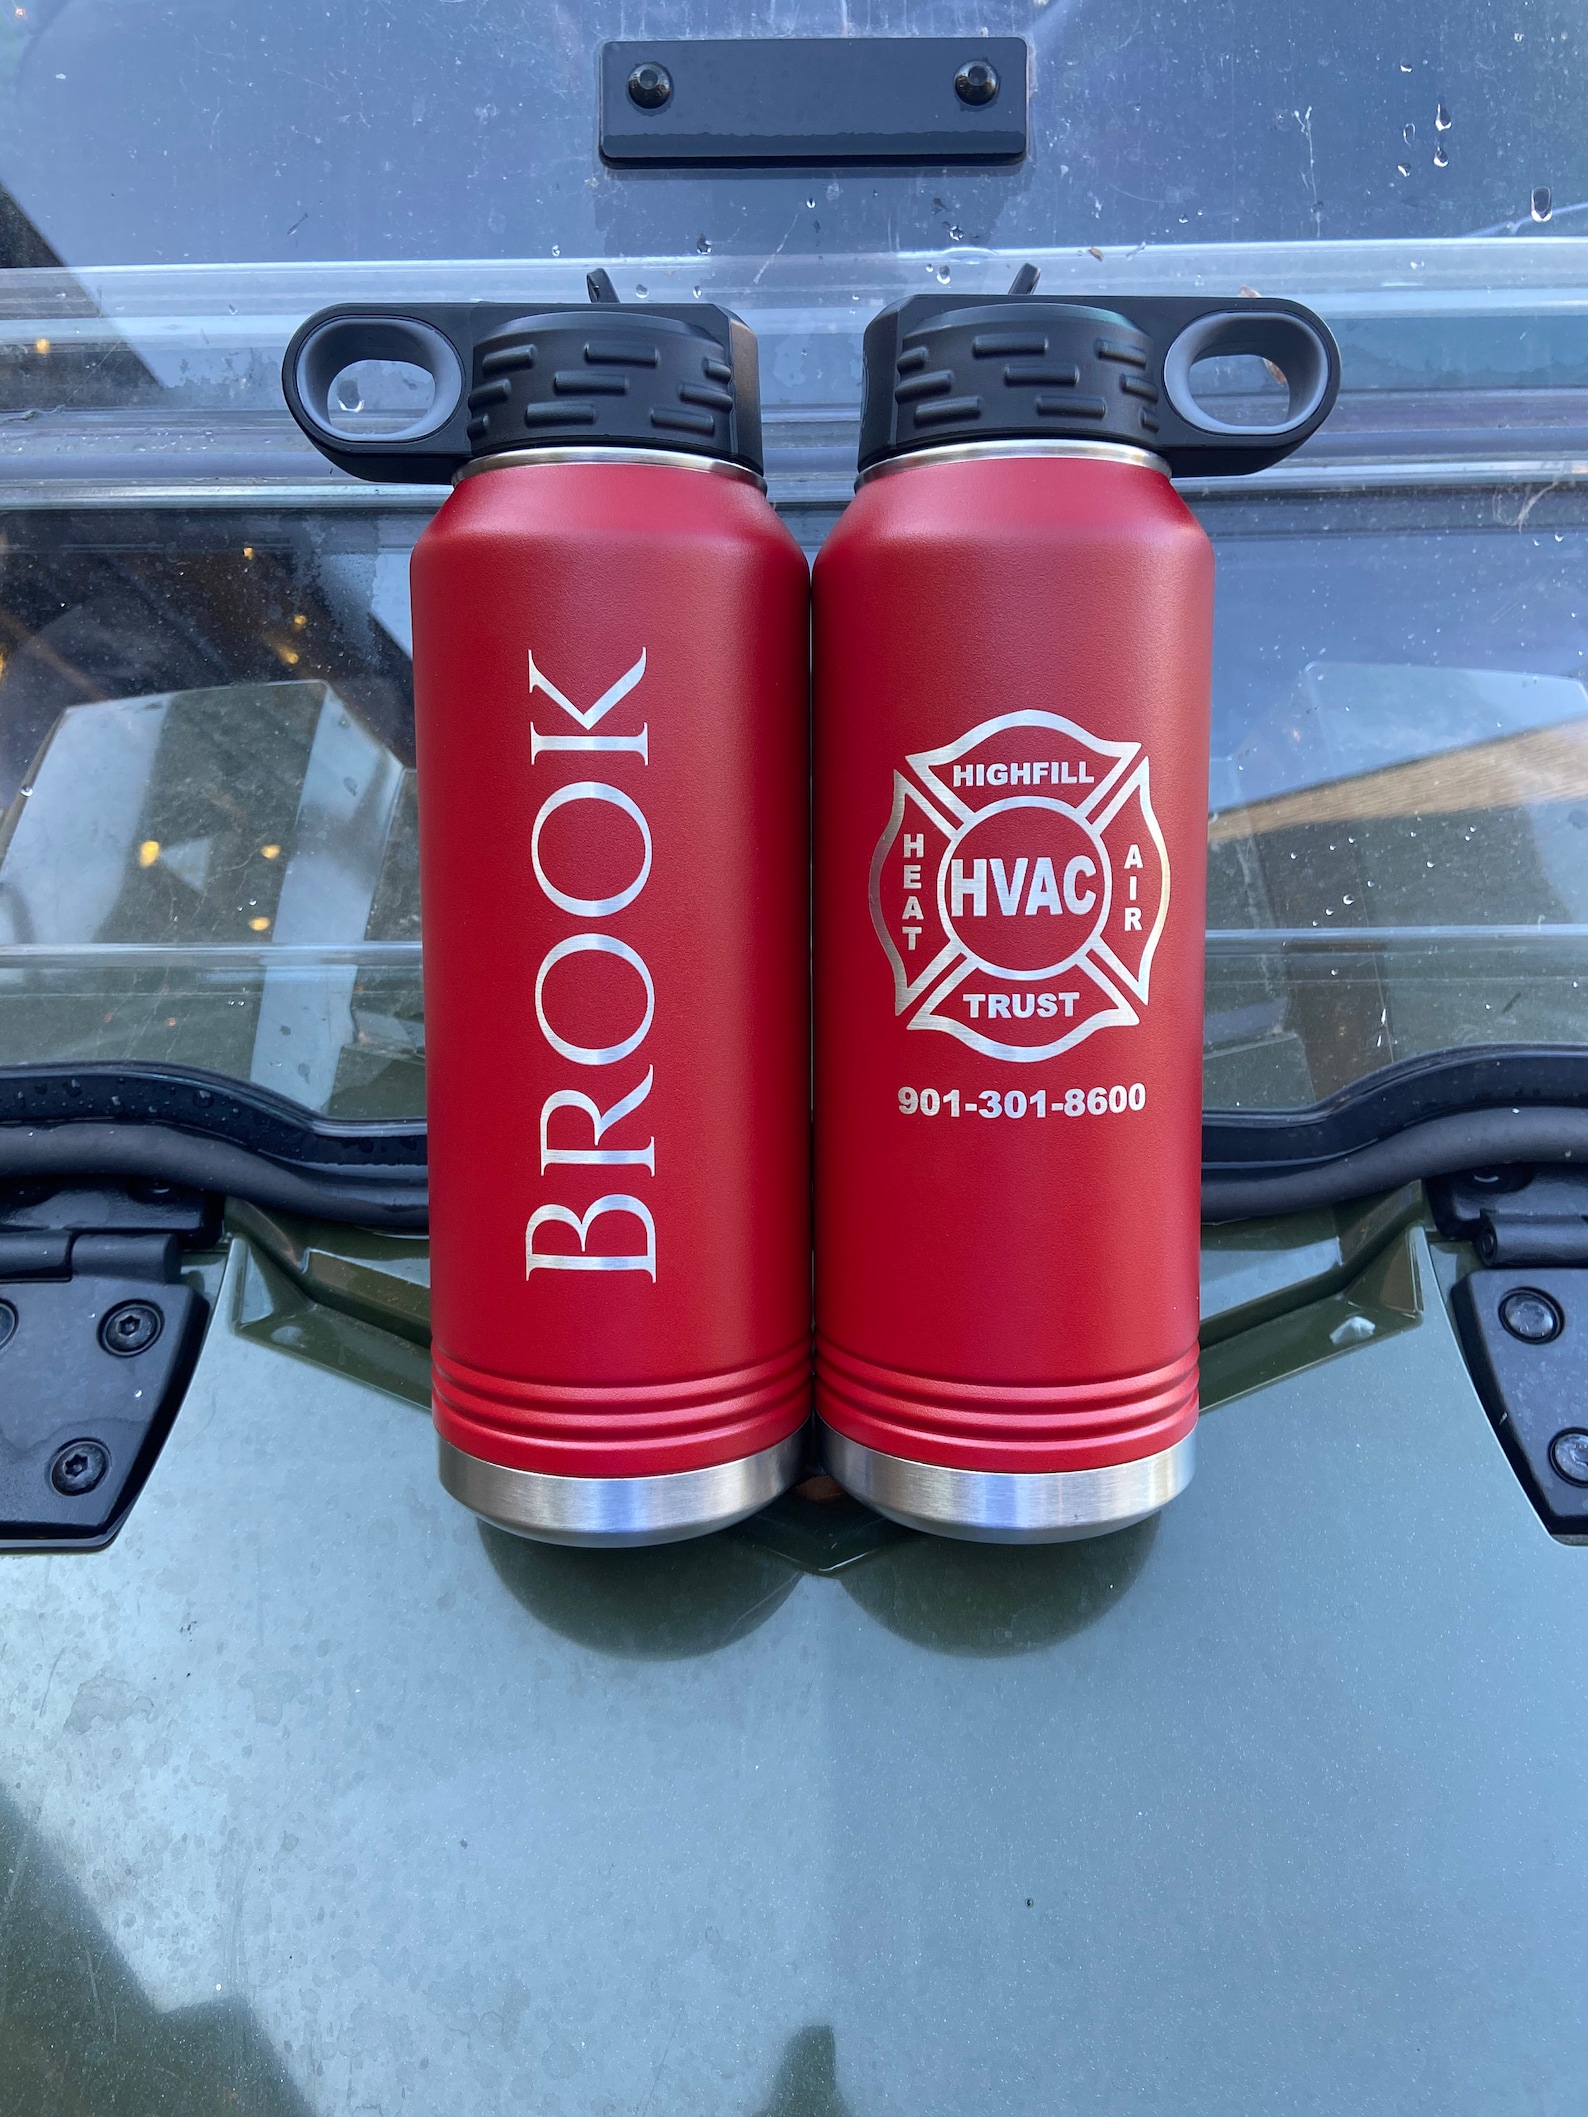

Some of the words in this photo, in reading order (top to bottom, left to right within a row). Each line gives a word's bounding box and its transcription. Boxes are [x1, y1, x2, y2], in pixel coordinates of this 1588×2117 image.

[952, 761, 1096, 788] HIGHFILL
[902, 833, 925, 951] HEAT
[950, 854, 1098, 917] HVAC
[1123, 843, 1144, 932] AIR
[525, 646, 657, 1284] BROOK
[962, 991, 1080, 1019] TRUST
[898, 1082, 1147, 1119] 901-301-8600
